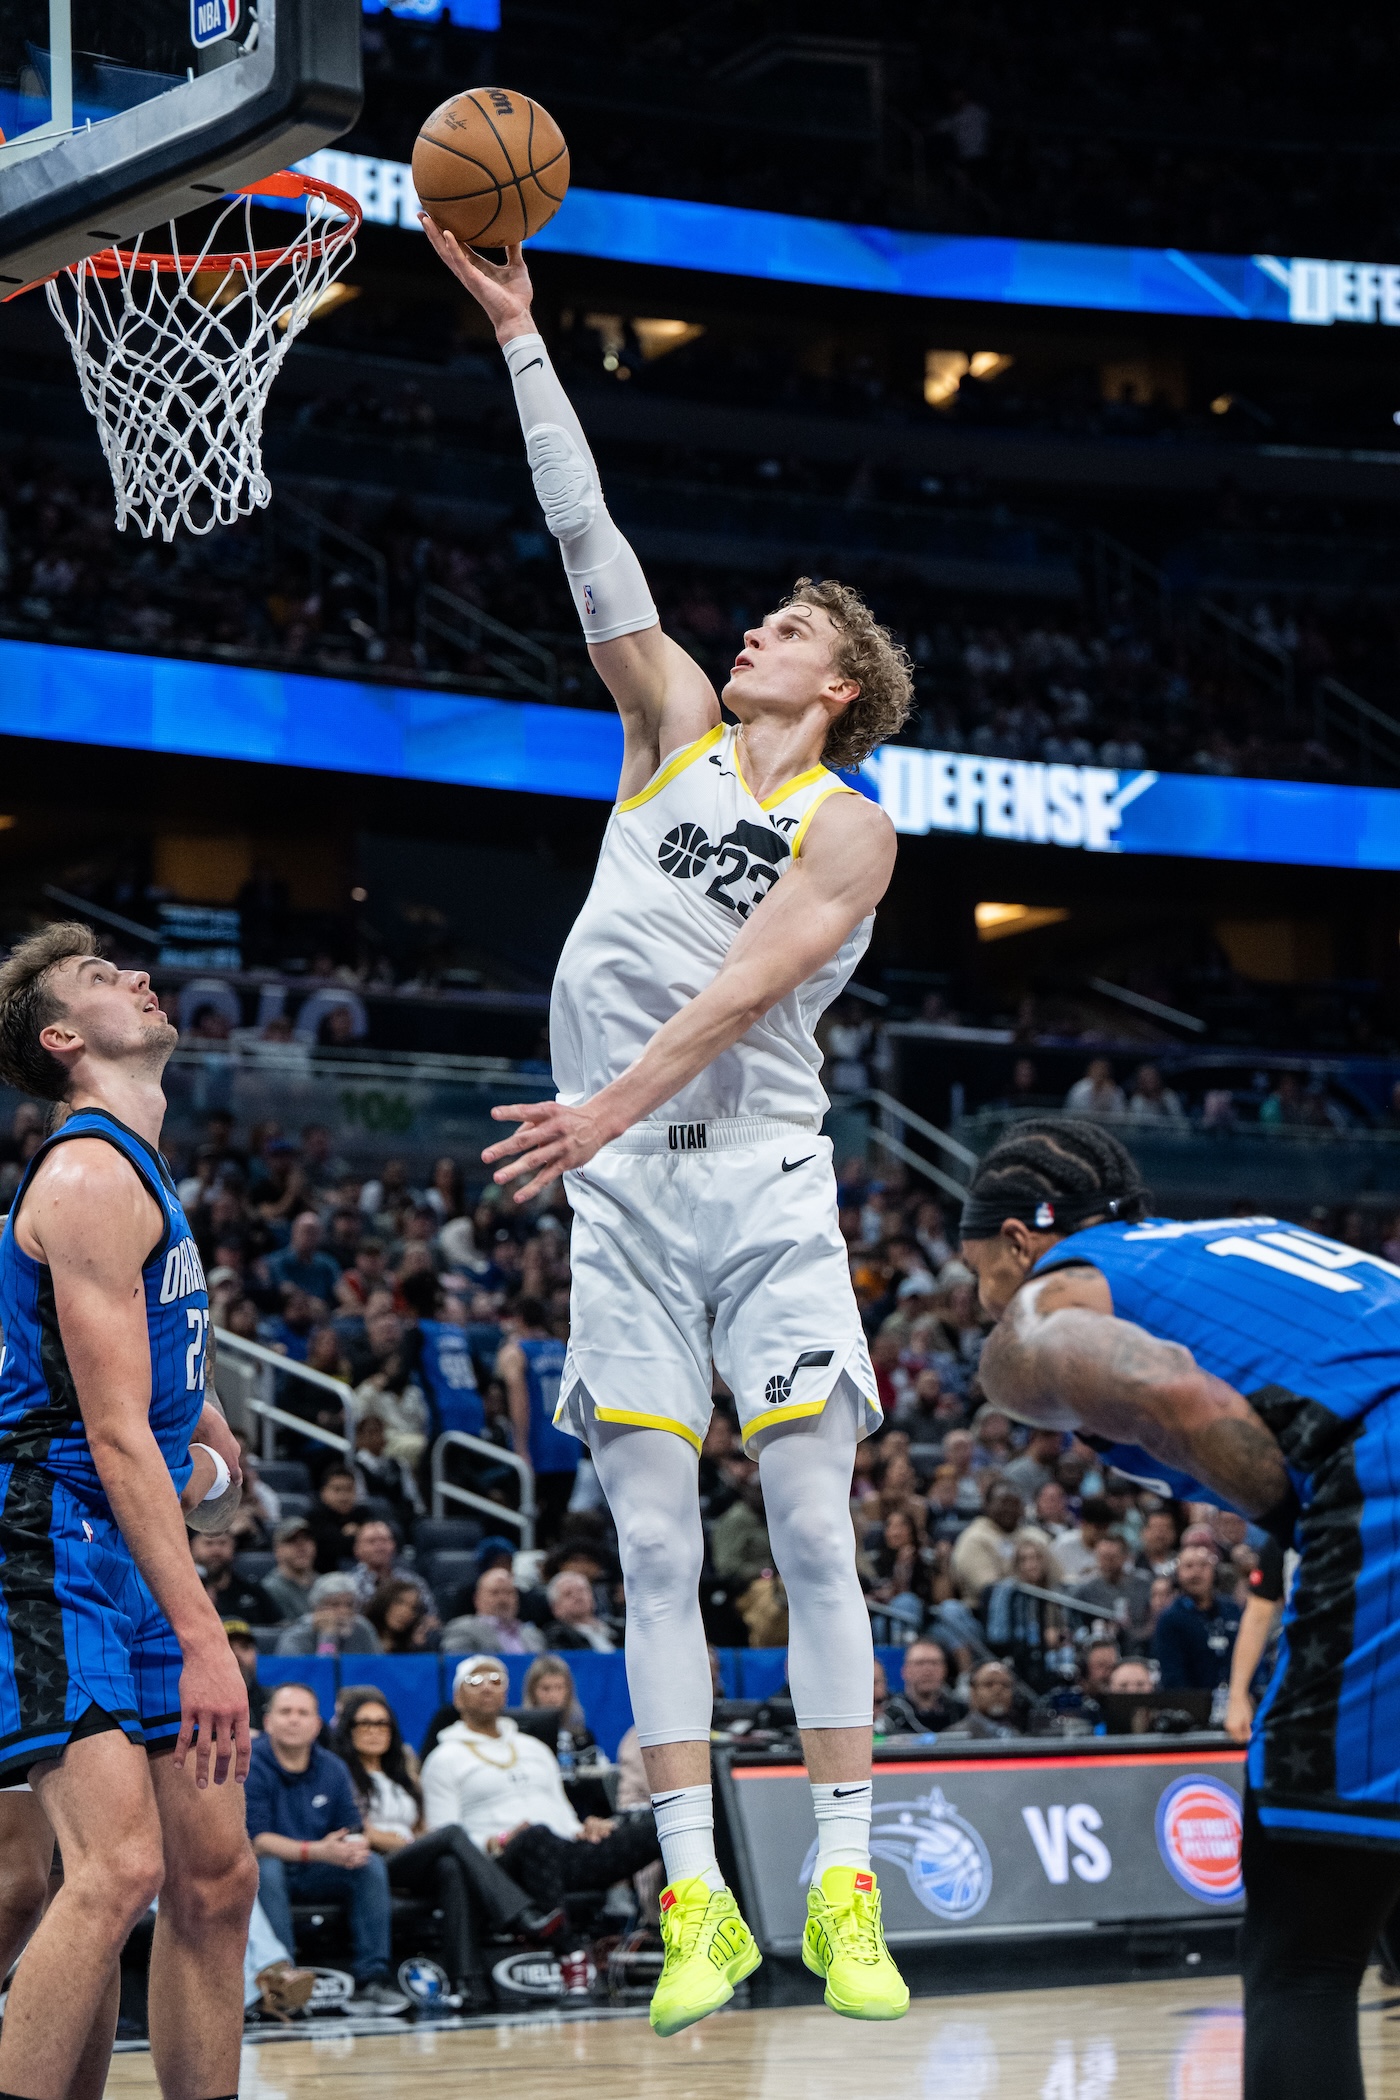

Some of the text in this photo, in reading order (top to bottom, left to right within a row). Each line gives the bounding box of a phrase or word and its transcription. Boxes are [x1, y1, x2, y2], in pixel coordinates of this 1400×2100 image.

[198, 0, 221, 35] NBA
[879, 745, 1123, 853] DEFENSE
[705, 848, 780, 920] 23
[669, 1124, 706, 1149] UTAH
[1205, 1230, 1400, 1293] 14
[1022, 1803, 1112, 1884] VS
[707, 1917, 747, 1971] AIR
